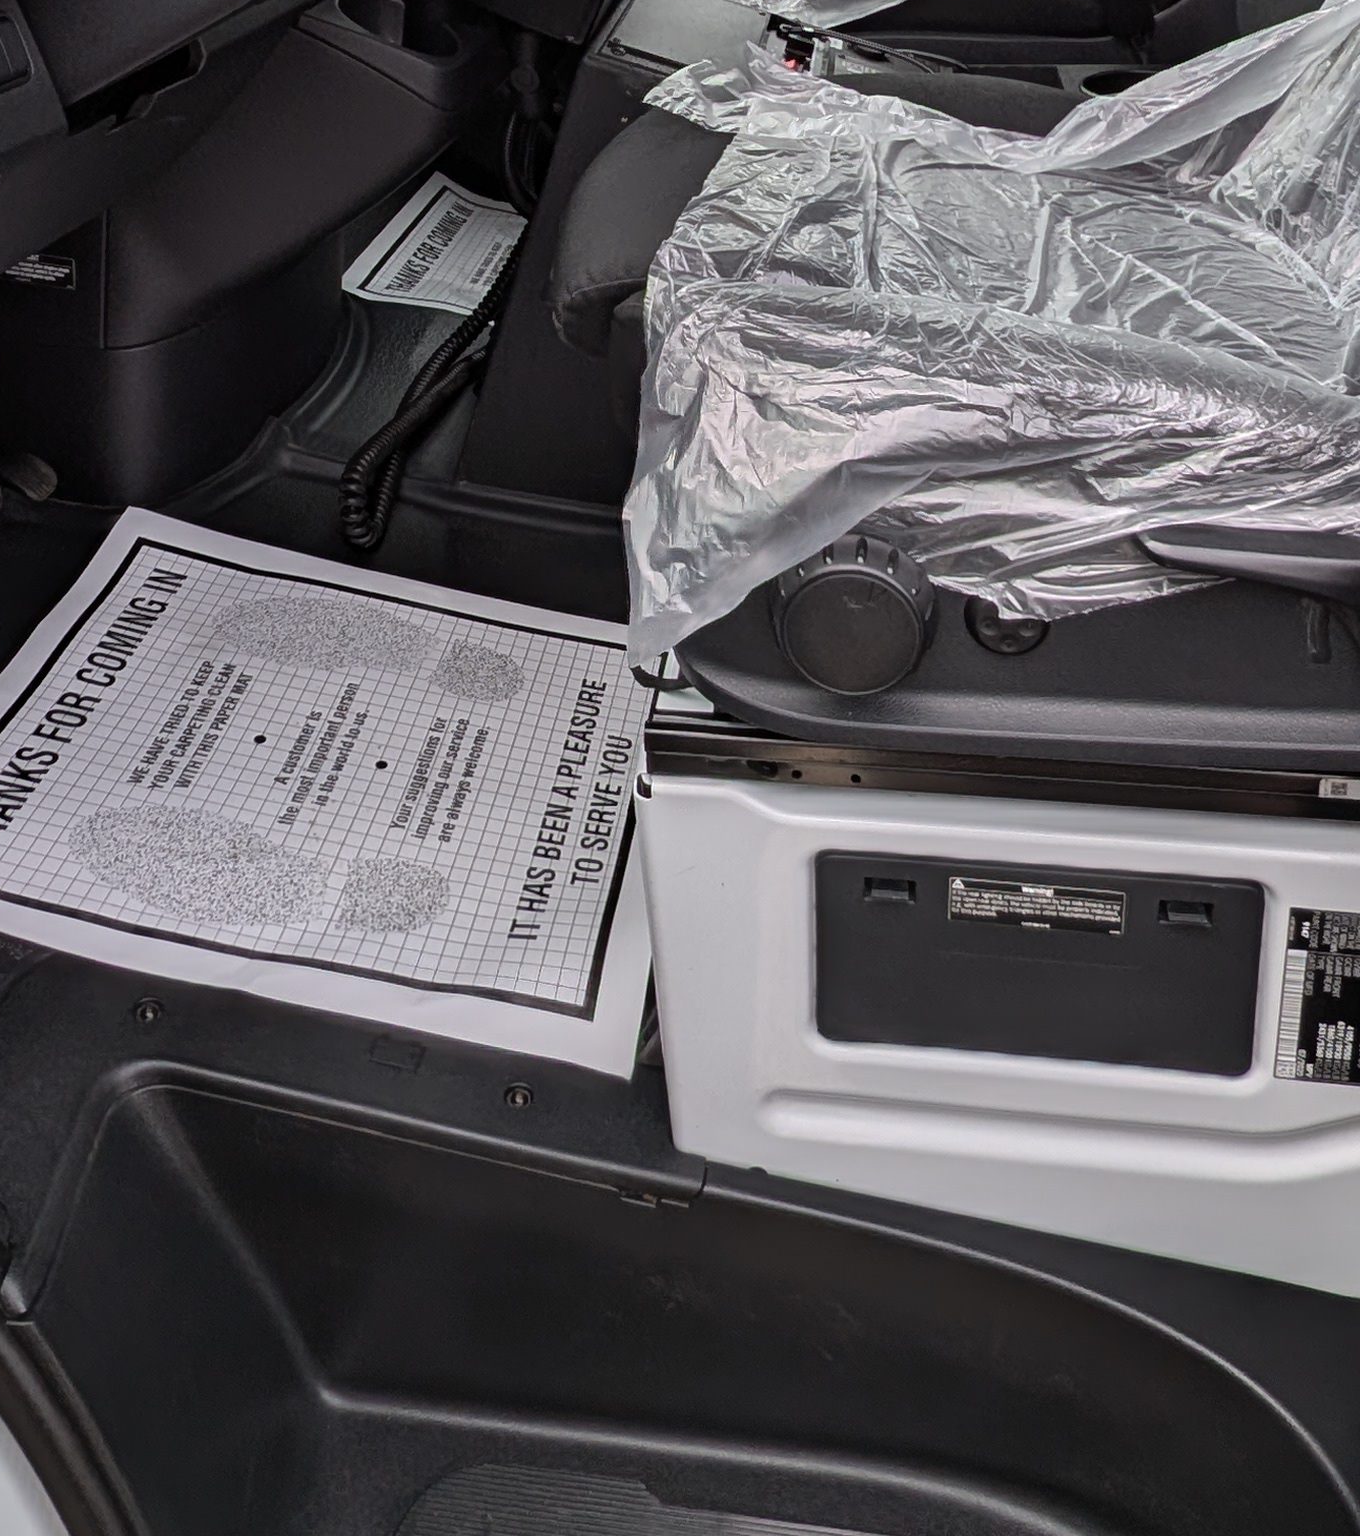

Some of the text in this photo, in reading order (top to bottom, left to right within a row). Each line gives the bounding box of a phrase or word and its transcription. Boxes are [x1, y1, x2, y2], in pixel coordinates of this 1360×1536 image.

[384, 201, 474, 292] THANKS FOR COMING IN
[32, 691, 101, 743] FOR
[76, 597, 167, 686] COMING
[142, 567, 187, 594] IN
[127, 660, 214, 783] WE HAVE TRIED TO KEEP
[148, 663, 236, 788] YOUR CARPETING CLEAN
[173, 671, 252, 788] WITH THIS PAPER MAT
[273, 710, 322, 785] A customer is
[277, 682, 360, 825] the most important person
[311, 708, 369, 806] in the world to us.
[388, 716, 447, 829] Your suggestions for
[411, 718, 470, 839] improving our service
[437, 725, 490, 842] are always welcome.
[507, 678, 606, 940] IT HAS BEEN A PLEASURE
[570, 734, 632, 885] TO SERVE YOU
